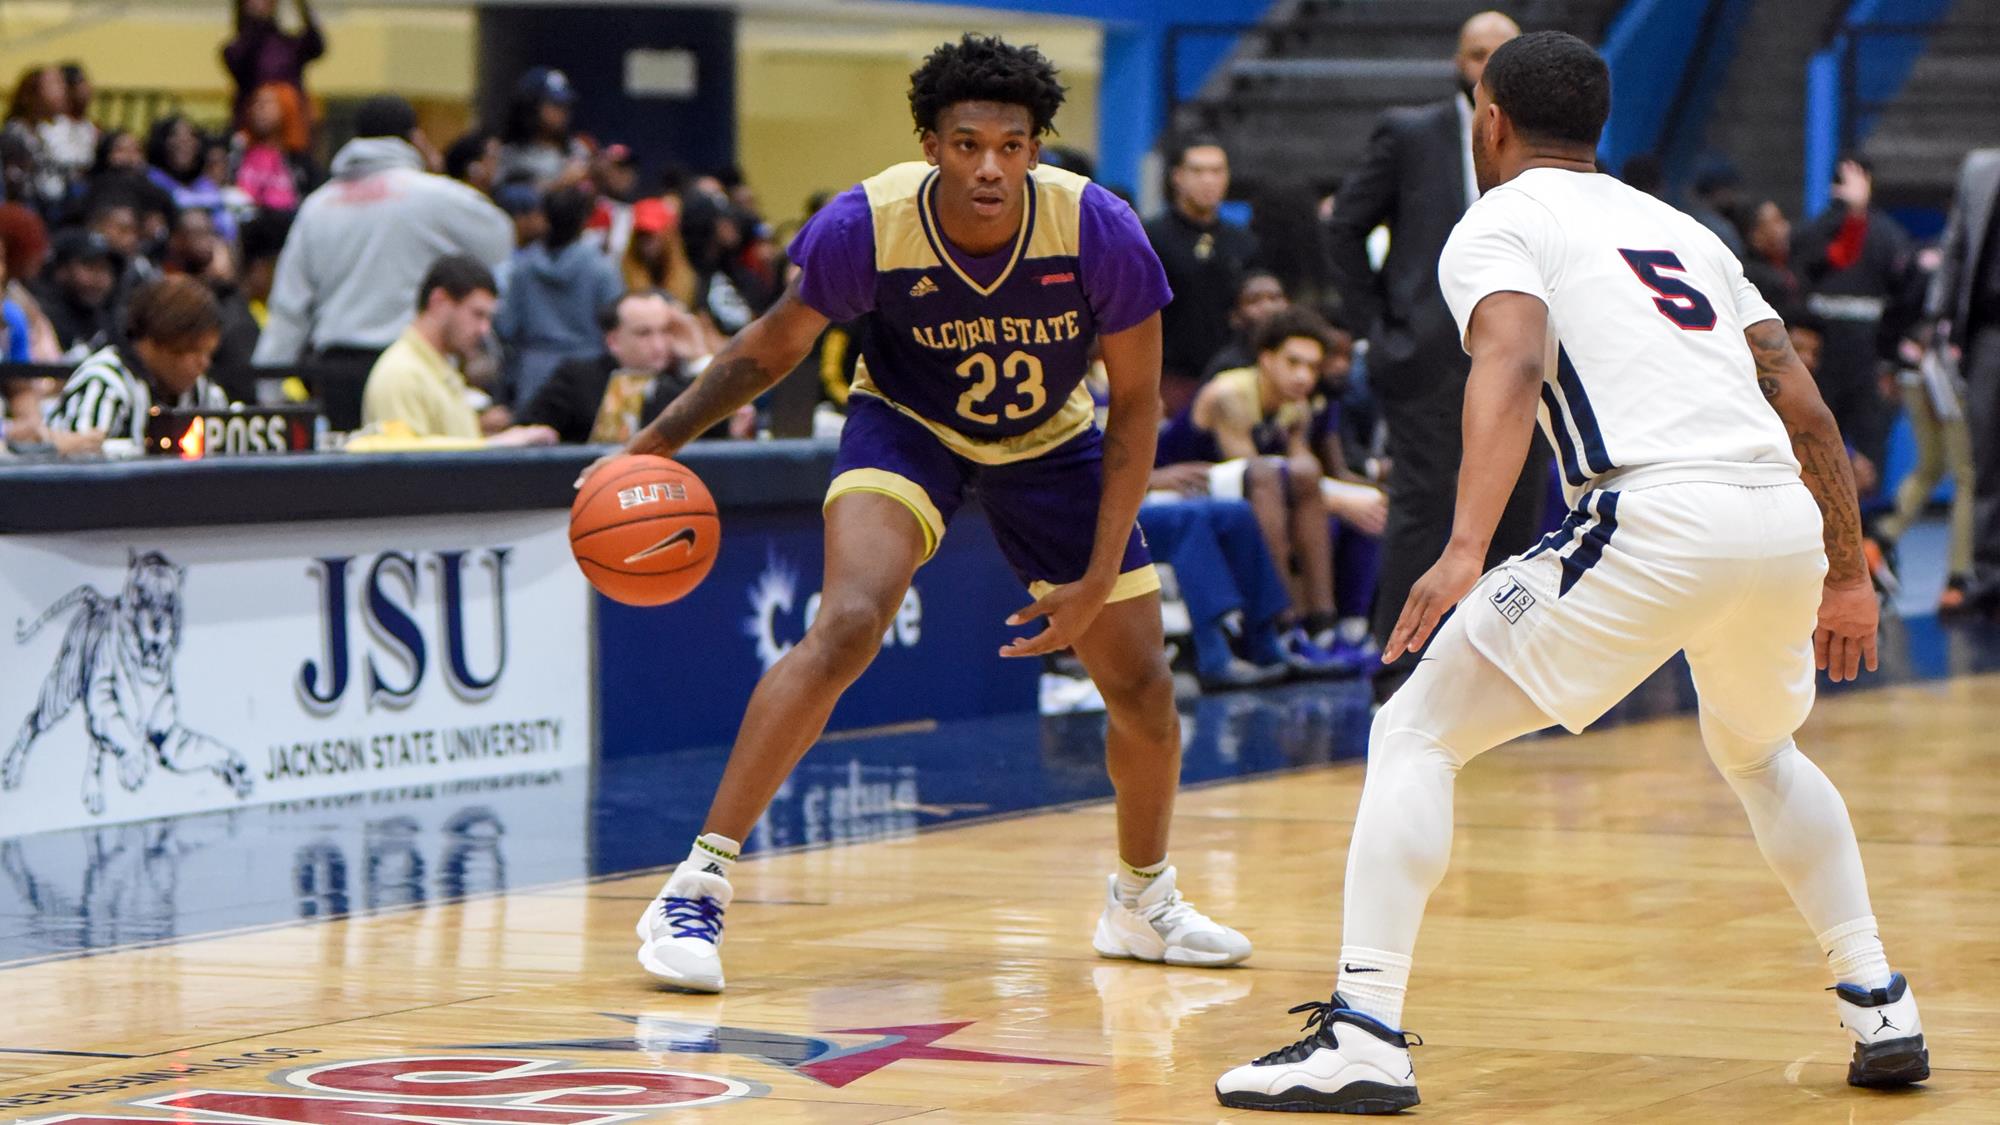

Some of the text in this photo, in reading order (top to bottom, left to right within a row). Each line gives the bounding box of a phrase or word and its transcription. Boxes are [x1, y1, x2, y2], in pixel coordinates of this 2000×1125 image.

[1616, 247, 1718, 331] 5
[912, 310, 1080, 351] ALCORN STATE
[955, 350, 1047, 425] 23
[204, 414, 287, 454] POSS
[294, 549, 512, 717] JSU
[265, 719, 564, 781] JACKSON STATE UNIVERSITY
